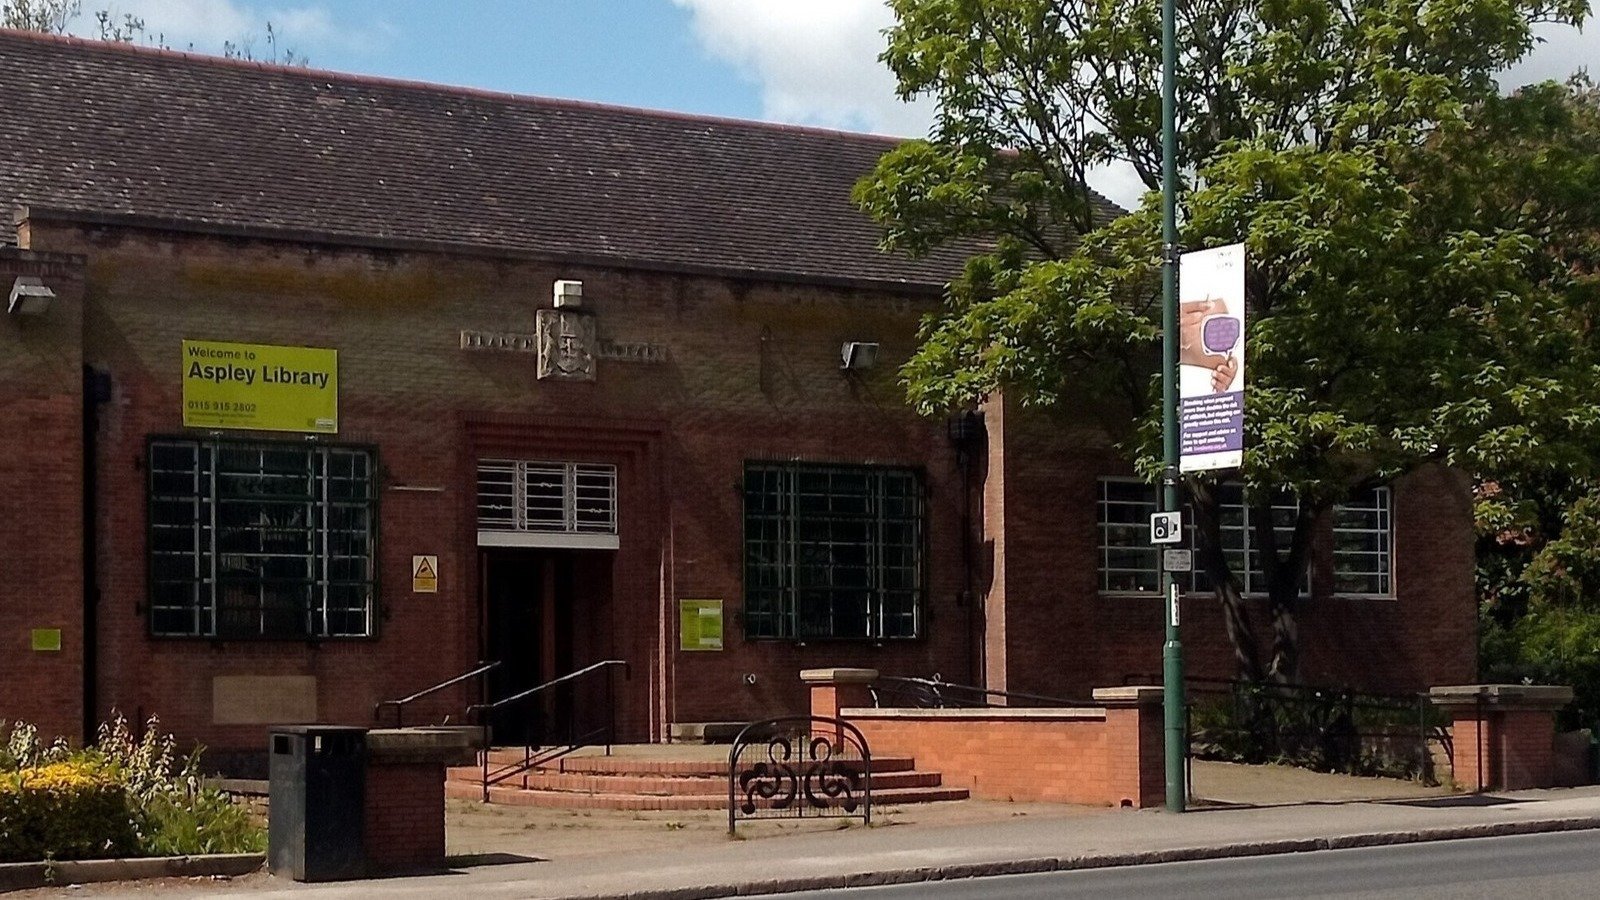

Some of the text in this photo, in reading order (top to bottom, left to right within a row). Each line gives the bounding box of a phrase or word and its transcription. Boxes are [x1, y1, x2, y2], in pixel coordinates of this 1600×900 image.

[188, 347, 256, 360] Welcome to
[188, 361, 329, 389] Aspley Library
[188, 401, 256, 412] 0115 915 2802
